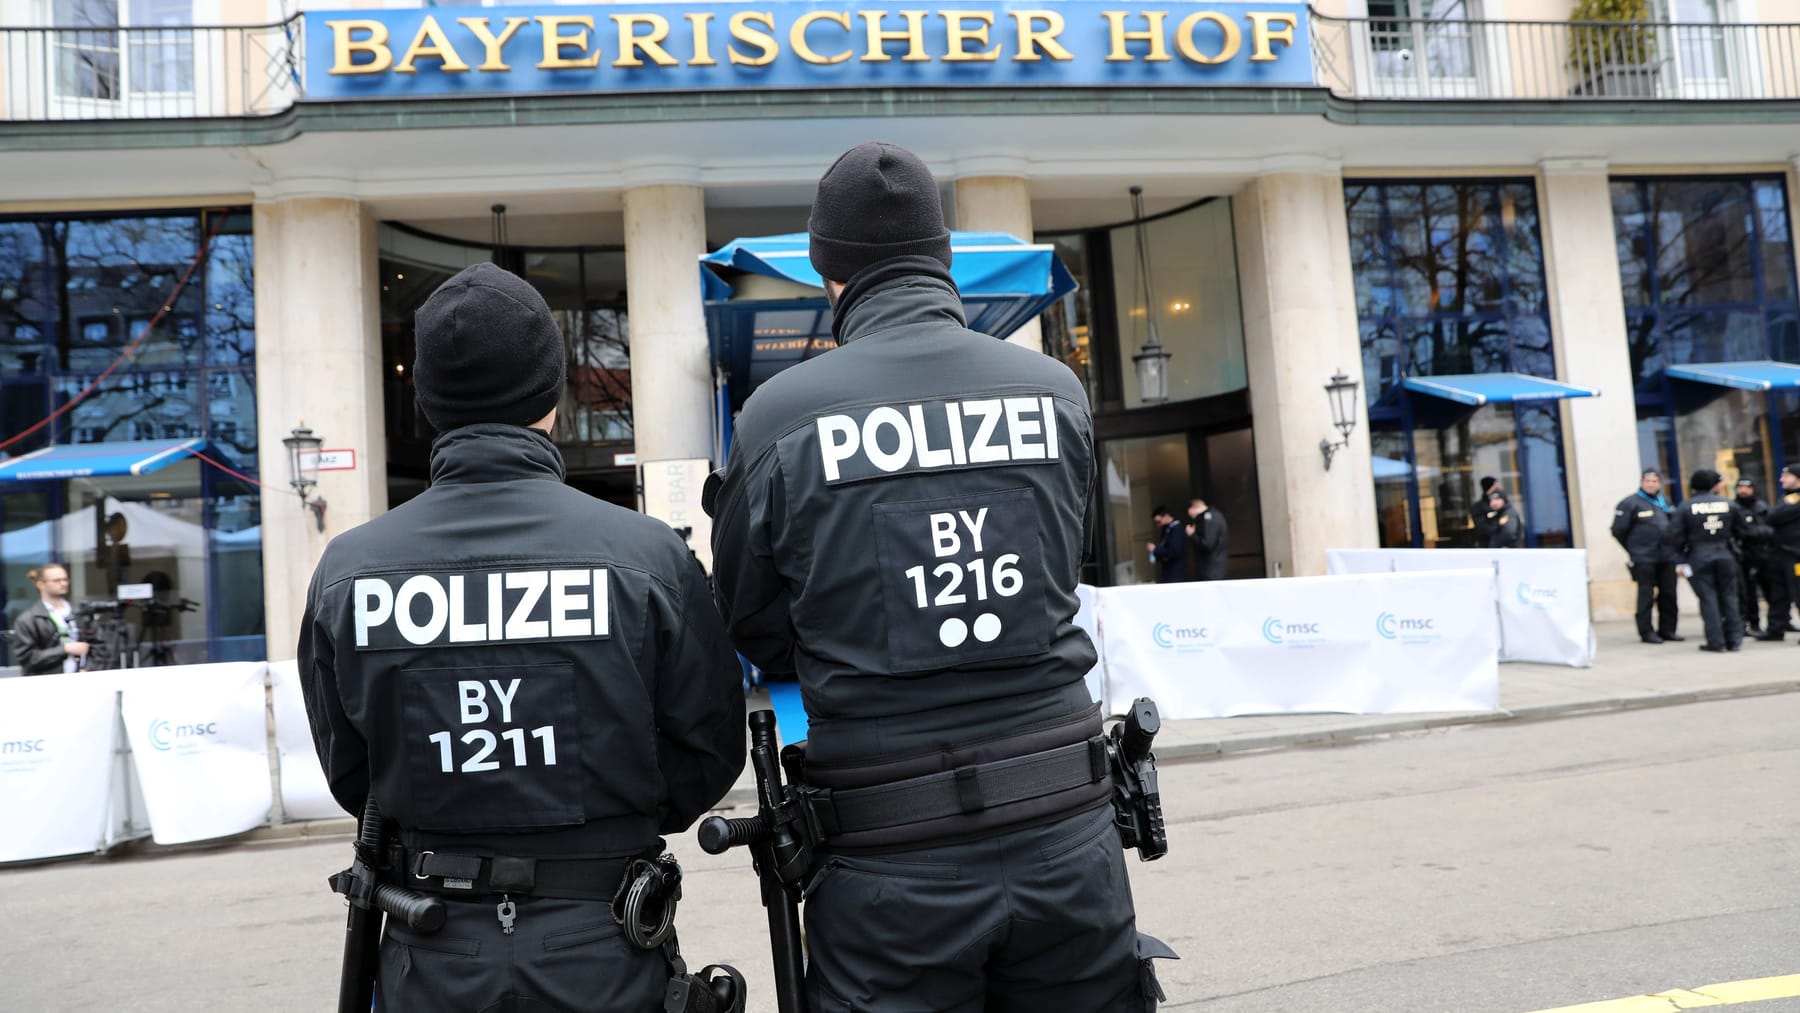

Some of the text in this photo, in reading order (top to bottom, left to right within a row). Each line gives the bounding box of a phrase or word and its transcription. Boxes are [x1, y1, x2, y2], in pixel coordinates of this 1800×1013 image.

[325, 9, 1298, 75] BAYERISCHER HOF
[817, 396, 1059, 482] POLIZEI
[667, 463, 686, 503] BAR
[930, 507, 988, 557] BY
[905, 553, 1024, 608] 1216
[354, 568, 609, 647] POLIZEI
[1286, 622, 1319, 634] msc
[1400, 618, 1433, 630] msc
[1176, 627, 1208, 639] msc
[458, 678, 521, 724] BY
[2, 738, 46, 753] msc
[176, 721, 217, 737] msc
[428, 725, 557, 773] 1211
